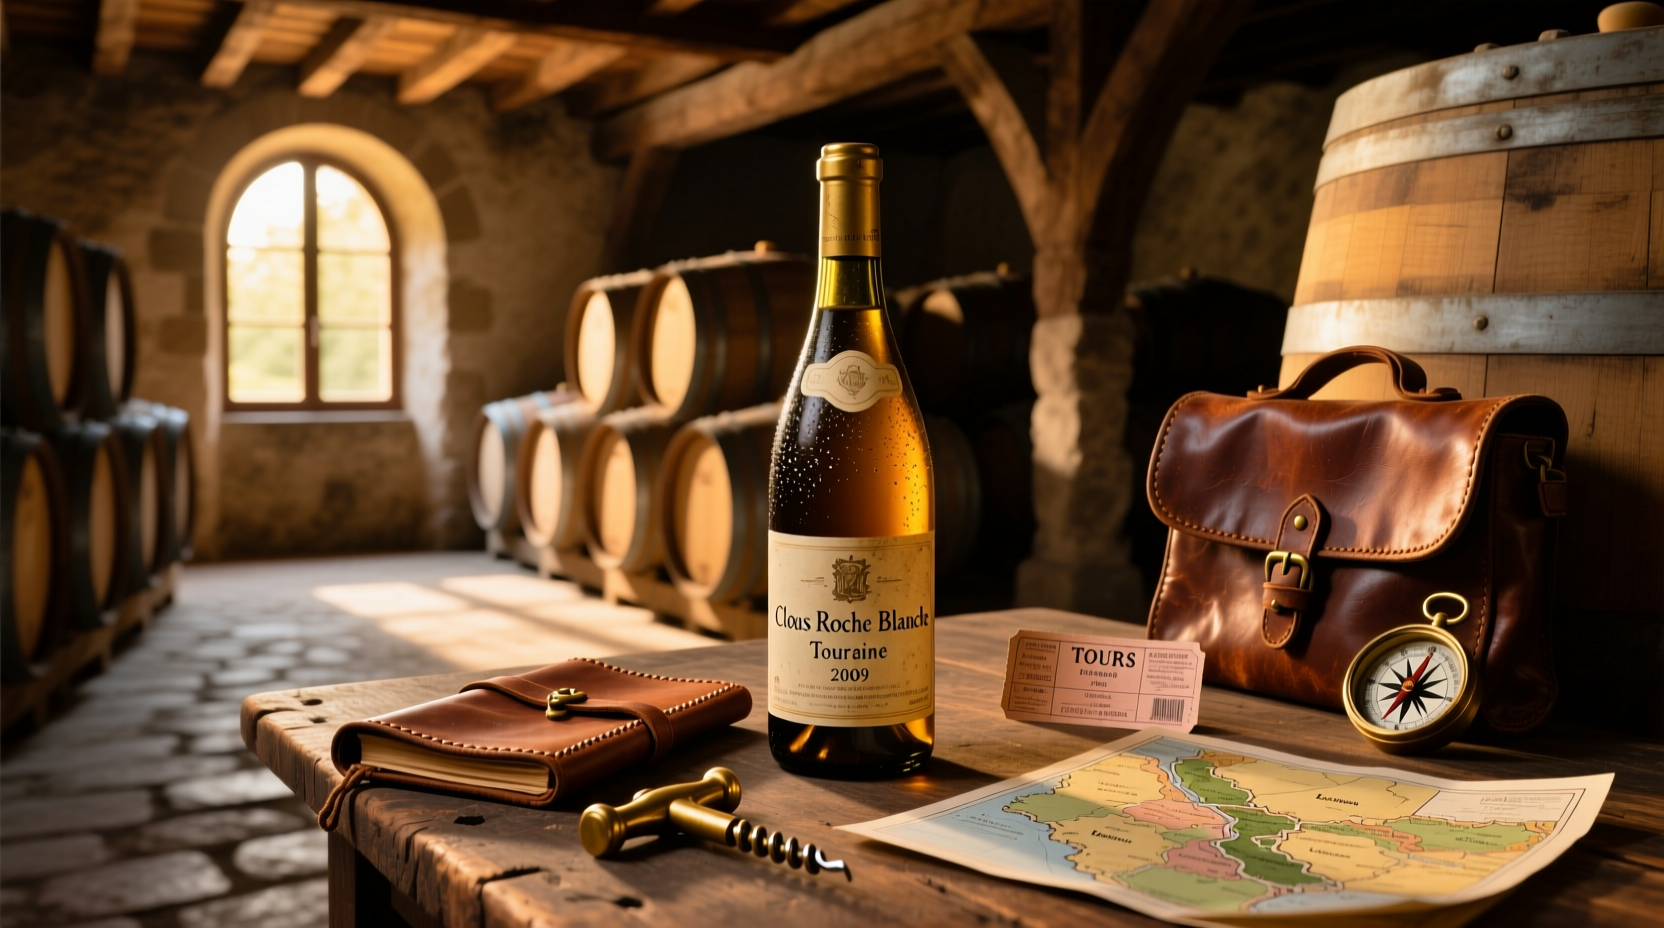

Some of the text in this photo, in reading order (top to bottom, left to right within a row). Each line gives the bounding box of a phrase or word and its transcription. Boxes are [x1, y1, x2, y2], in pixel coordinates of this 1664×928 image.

[816, 611, 872, 633] Roche
[809, 641, 888, 660] Touraine
[1071, 646, 1136, 668] TOURS
[830, 668, 869, 682] 2009
